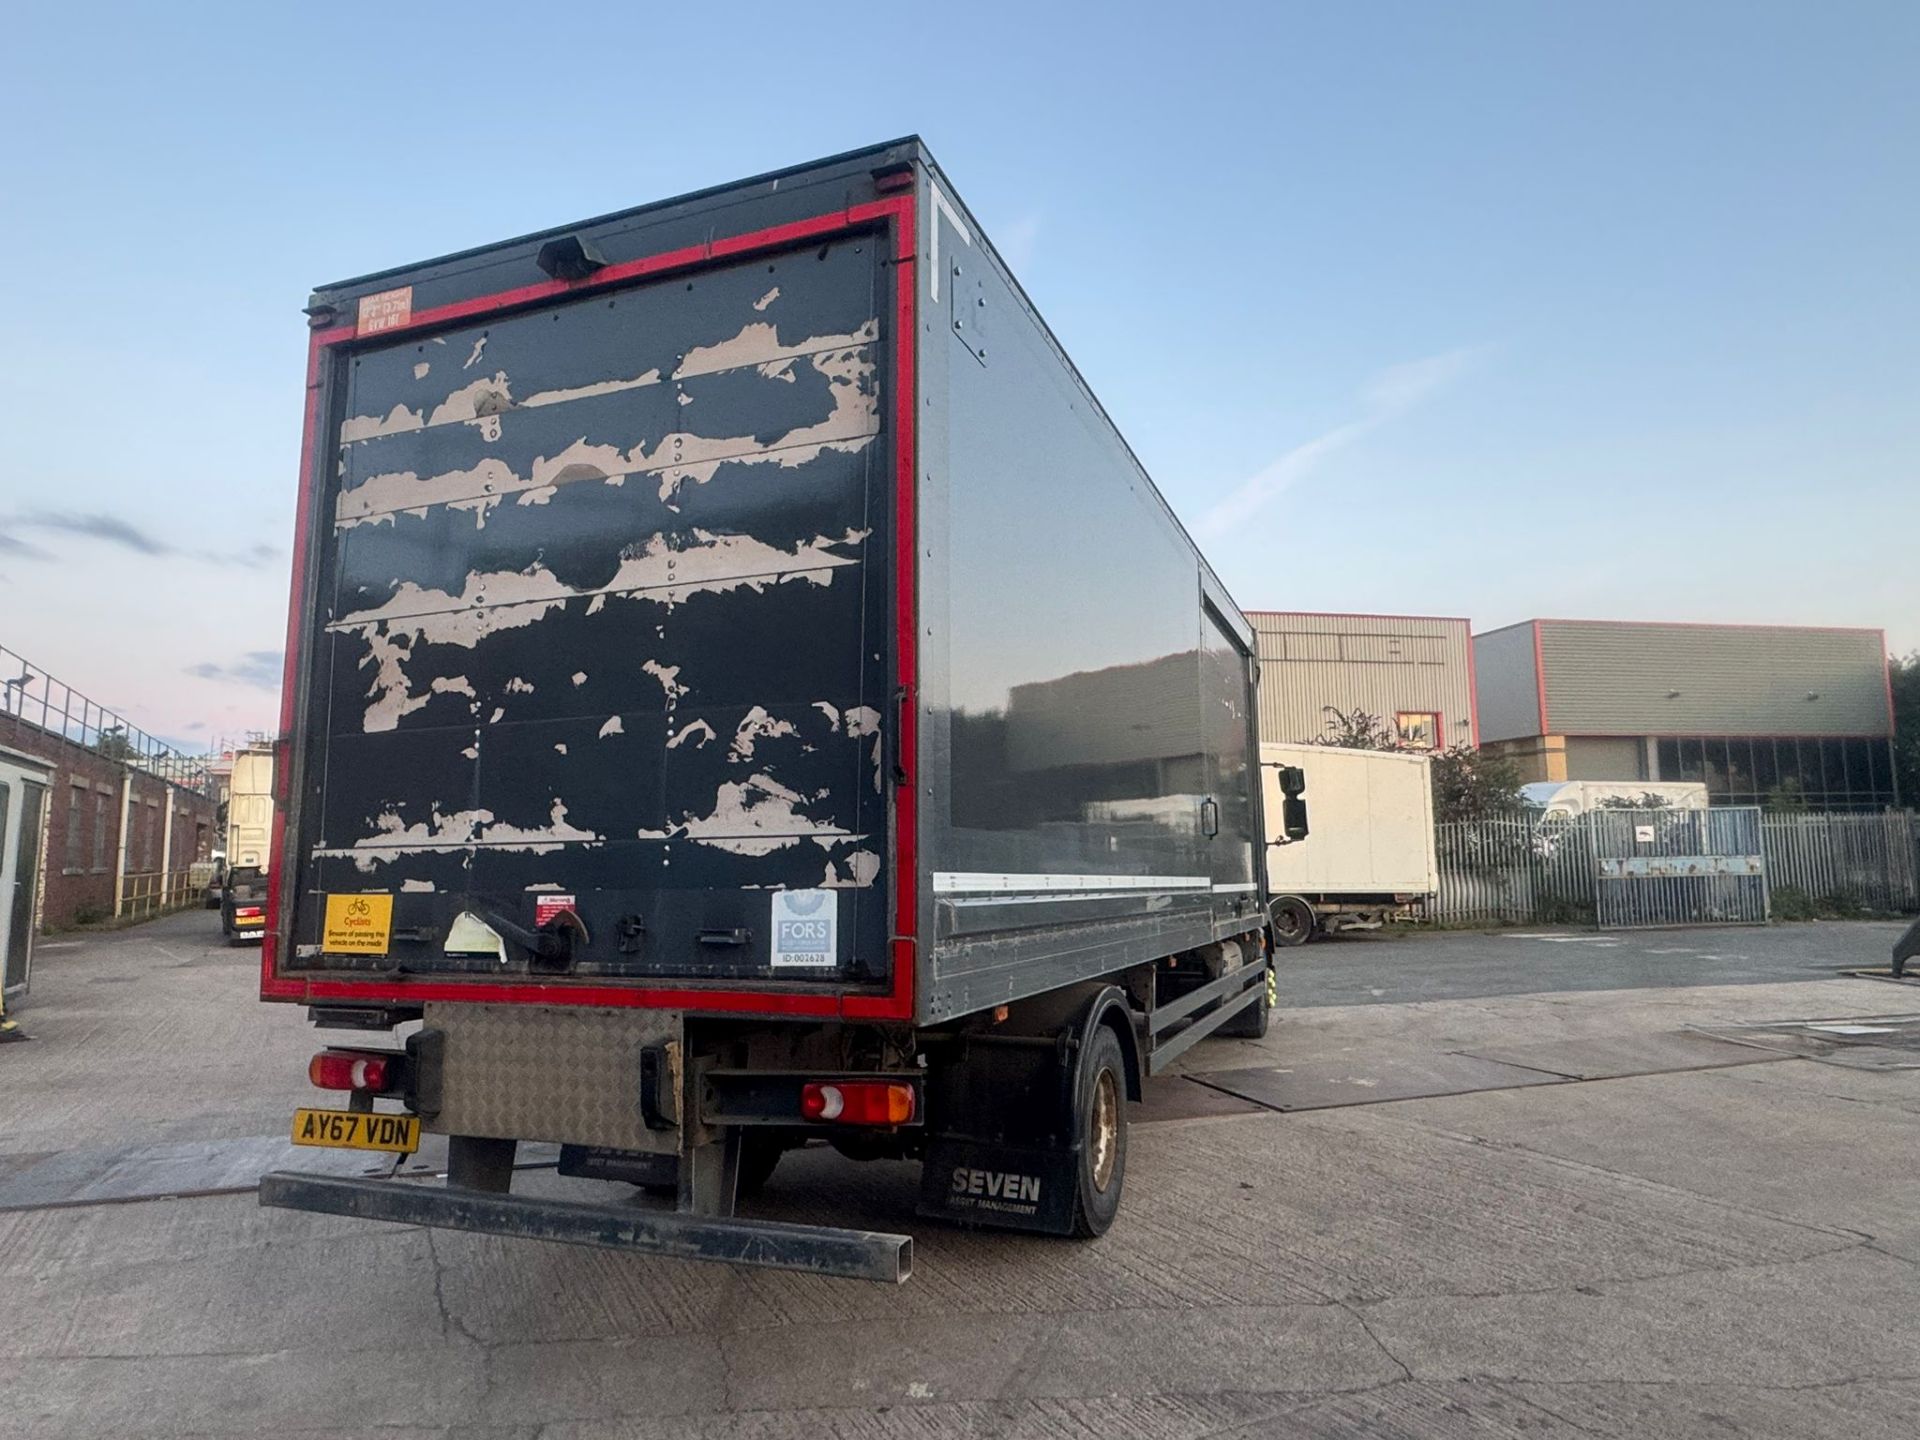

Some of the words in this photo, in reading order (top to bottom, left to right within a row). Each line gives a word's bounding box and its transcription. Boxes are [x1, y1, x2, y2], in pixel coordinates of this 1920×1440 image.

[344, 917, 371, 927] Cyclists
[781, 922, 826, 938] FORS
[355, 931, 375, 939] passing
[301, 1113, 359, 1142] AY67
[366, 1118, 410, 1145] VDN
[952, 1167, 1041, 1202] SEVEN
[977, 1199, 1038, 1215] MANAGEMENT
